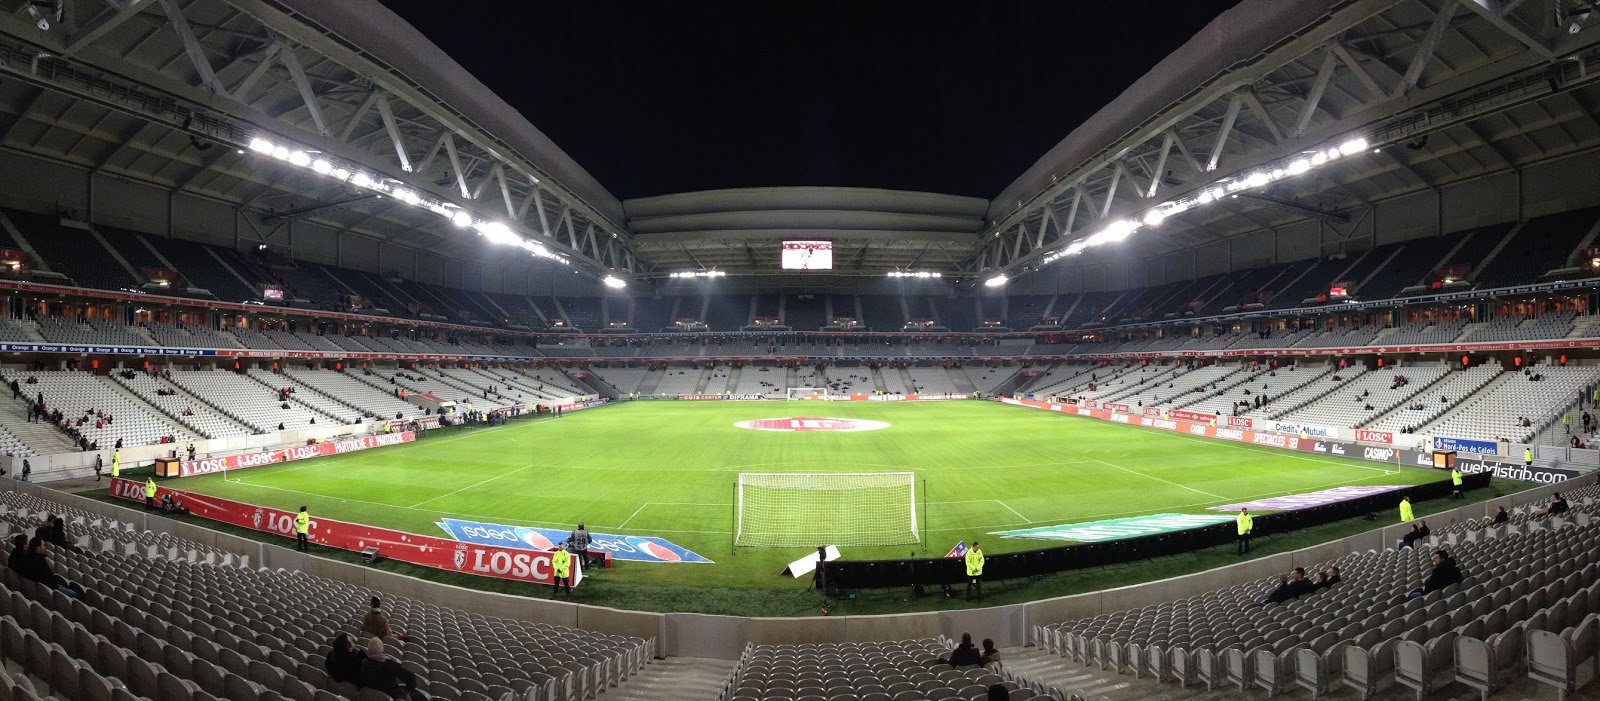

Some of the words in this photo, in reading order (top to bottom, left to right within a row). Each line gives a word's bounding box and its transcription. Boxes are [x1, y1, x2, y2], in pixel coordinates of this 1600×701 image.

[1233, 416, 1248, 426] LOSC
[1190, 424, 1206, 434] CASINO
[1254, 433, 1286, 447] SPECTACLES
[1276, 423, 1294, 433] Crédit
[1304, 427, 1326, 436] Mutuel
[1363, 432, 1388, 442] LOSC
[334, 438, 367, 453] PARTOUCHE
[376, 433, 404, 446] PARTOUCHE
[292, 447, 319, 458] LOSC
[1444, 444, 1468, 452] Nord-Pas
[1478, 446, 1496, 454] Calais
[192, 458, 227, 474] LOSC
[1461, 461, 1568, 484] webdistrib.com
[123, 483, 146, 500] LOS
[460, 526, 518, 542] pepsi
[473, 549, 550, 580] LOSC
